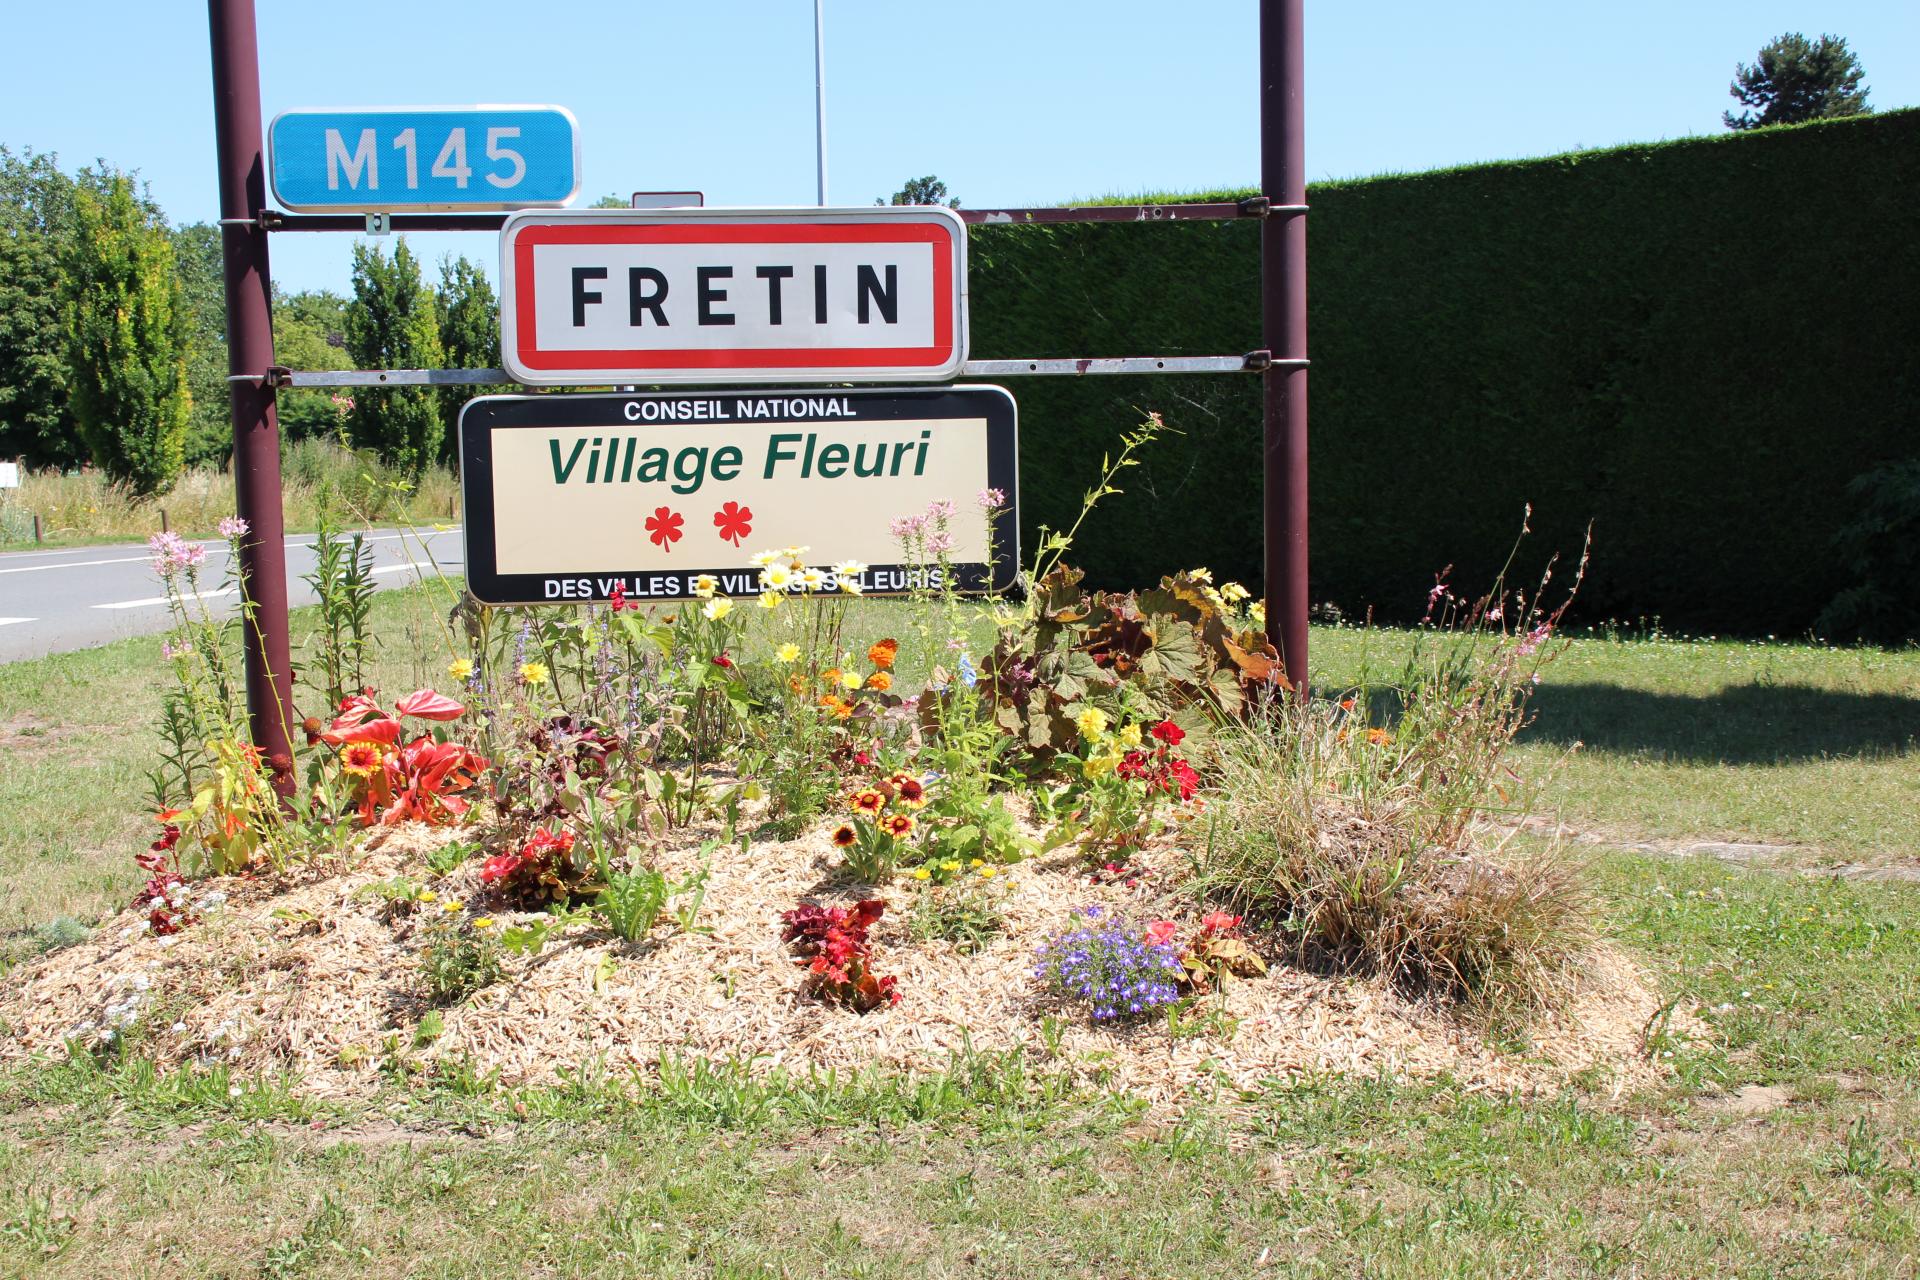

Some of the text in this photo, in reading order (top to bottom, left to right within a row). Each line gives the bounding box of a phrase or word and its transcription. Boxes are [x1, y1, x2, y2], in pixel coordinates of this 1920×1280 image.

[325, 127, 527, 190] M145
[571, 264, 898, 326] FRETIN
[624, 398, 856, 421] CONSEIL NATIONAL
[549, 430, 931, 495] Village Fleuri
[545, 578, 593, 598] DES
[598, 576, 680, 596] VILLES
